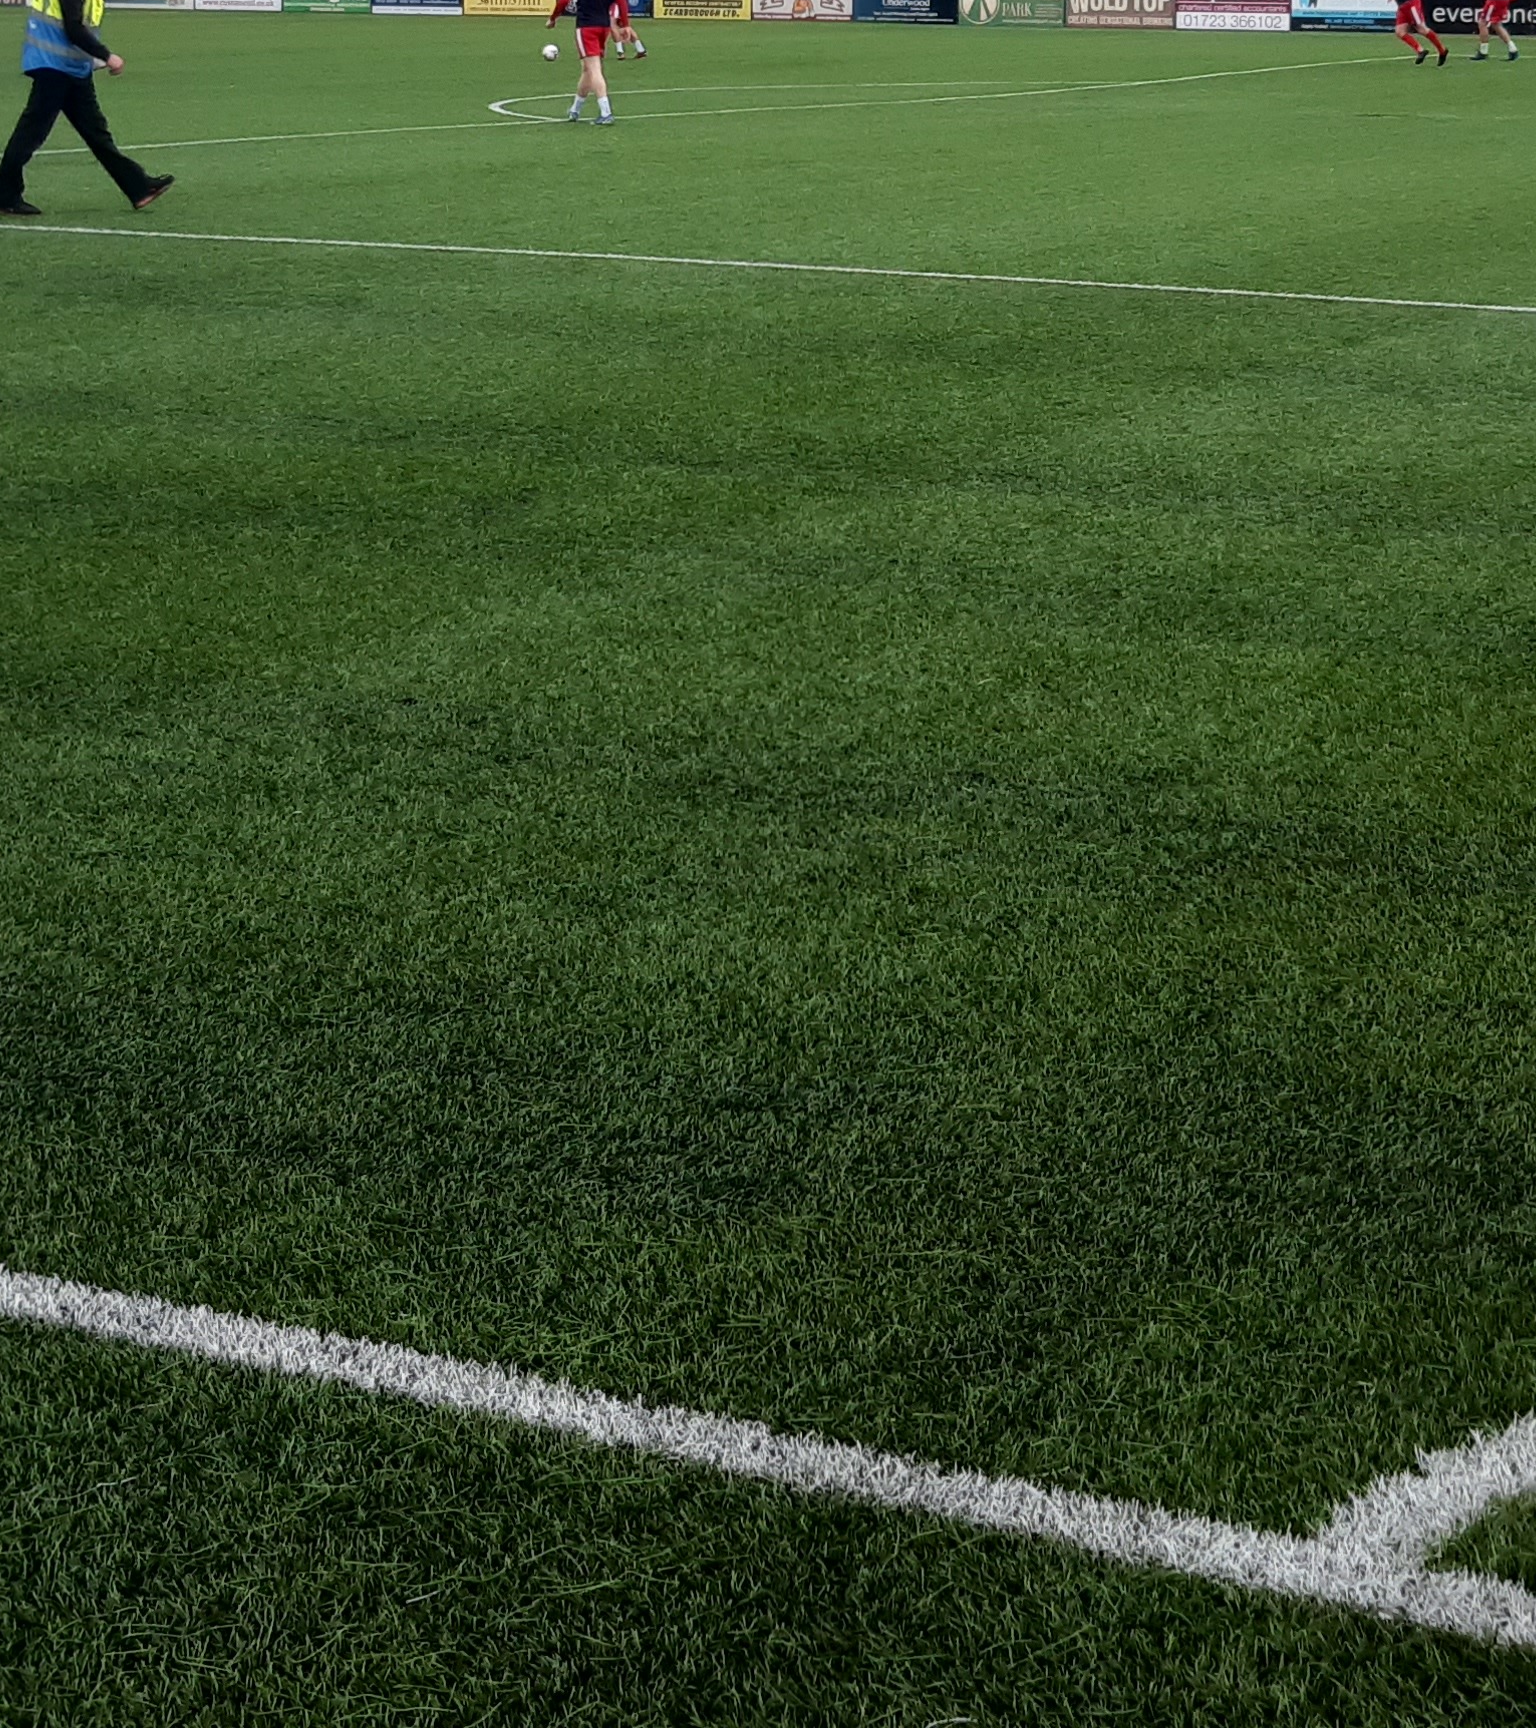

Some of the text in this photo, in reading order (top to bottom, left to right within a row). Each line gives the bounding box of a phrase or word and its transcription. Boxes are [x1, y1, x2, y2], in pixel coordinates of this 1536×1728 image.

[662, 8, 721, 17] SCARBOROUGH
[1002, 2, 1032, 17] PARK
[1183, 14, 1227, 28] 01723
[1230, 15, 1282, 29] 366102
